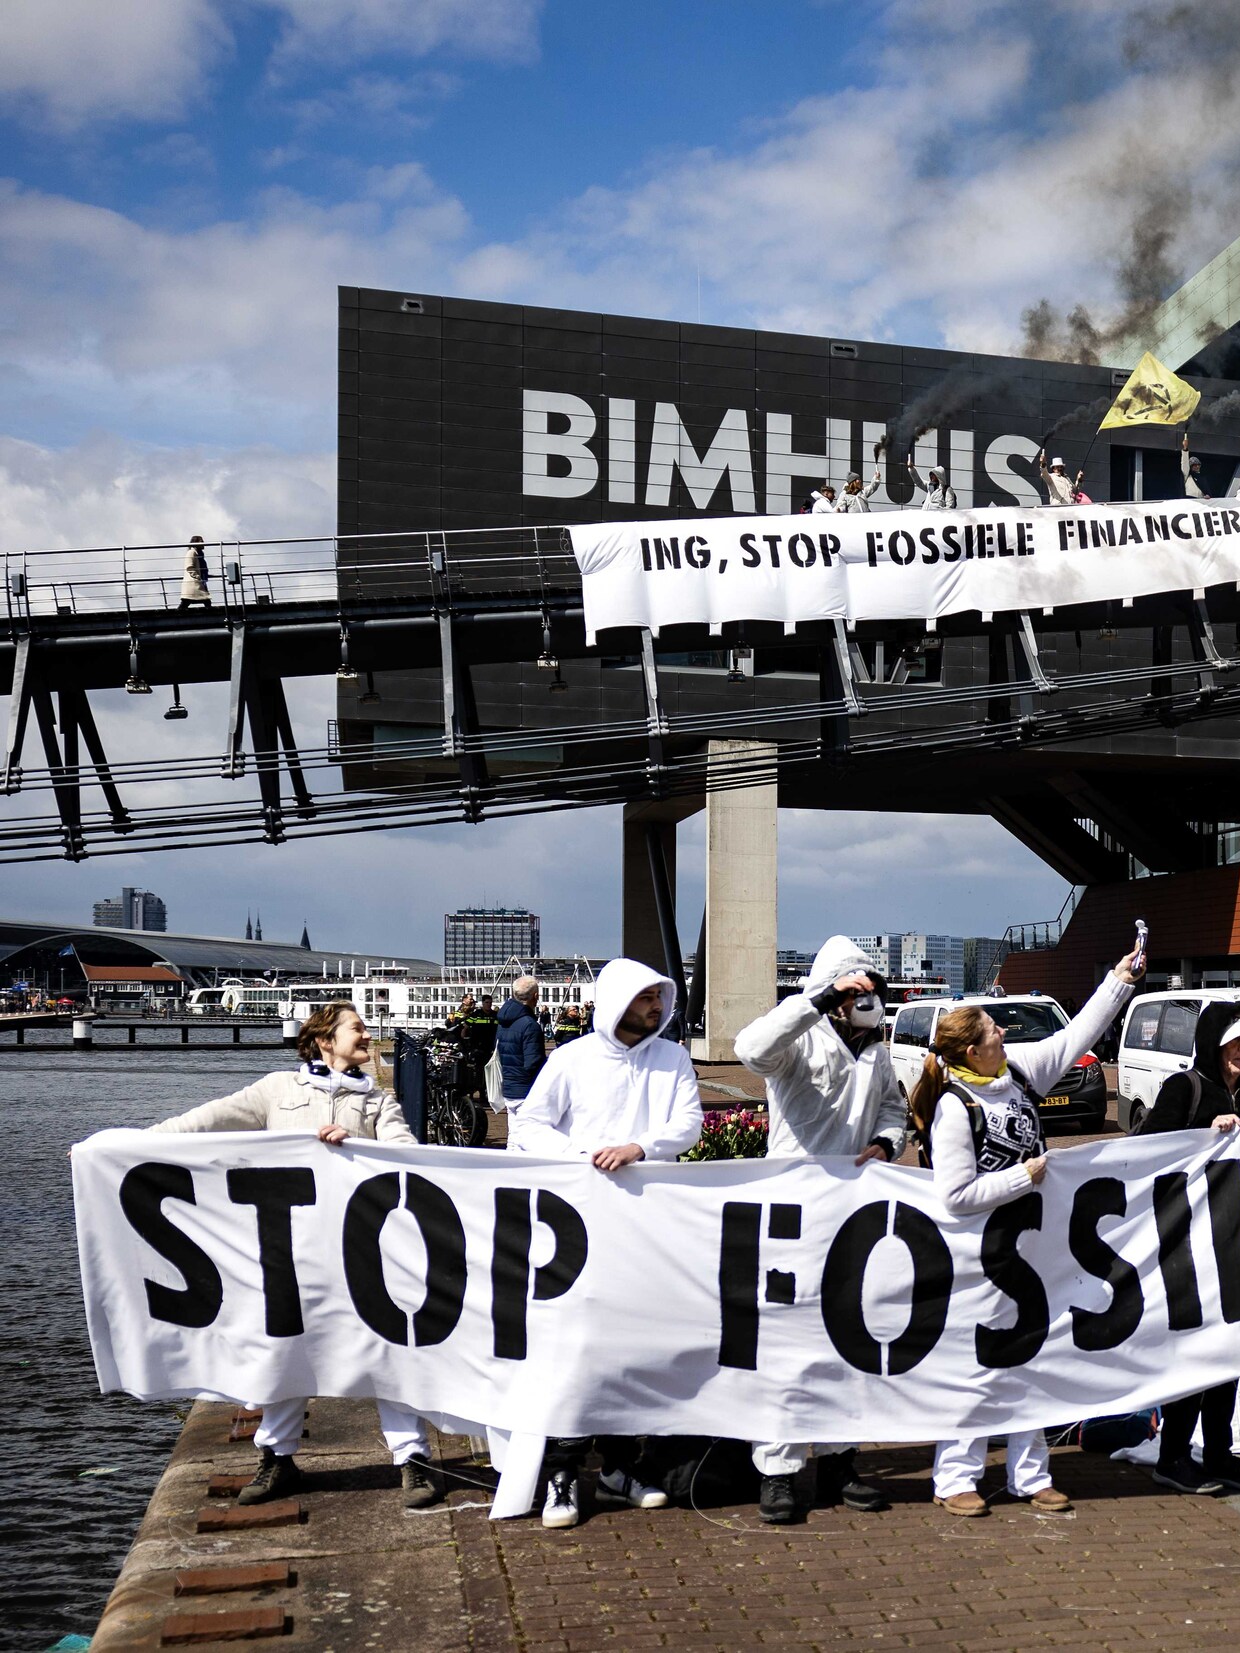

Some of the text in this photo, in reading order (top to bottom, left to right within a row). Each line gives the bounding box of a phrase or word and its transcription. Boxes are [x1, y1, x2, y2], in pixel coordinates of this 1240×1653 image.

[522, 388, 1043, 515] BIMHUIS
[640, 535, 729, 574] ING,
[740, 533, 841, 568] STOP
[866, 522, 1036, 567] FOSSIELE
[1044, 1097, 1067, 1105] 83-BT
[119, 1161, 588, 1361] STOP
